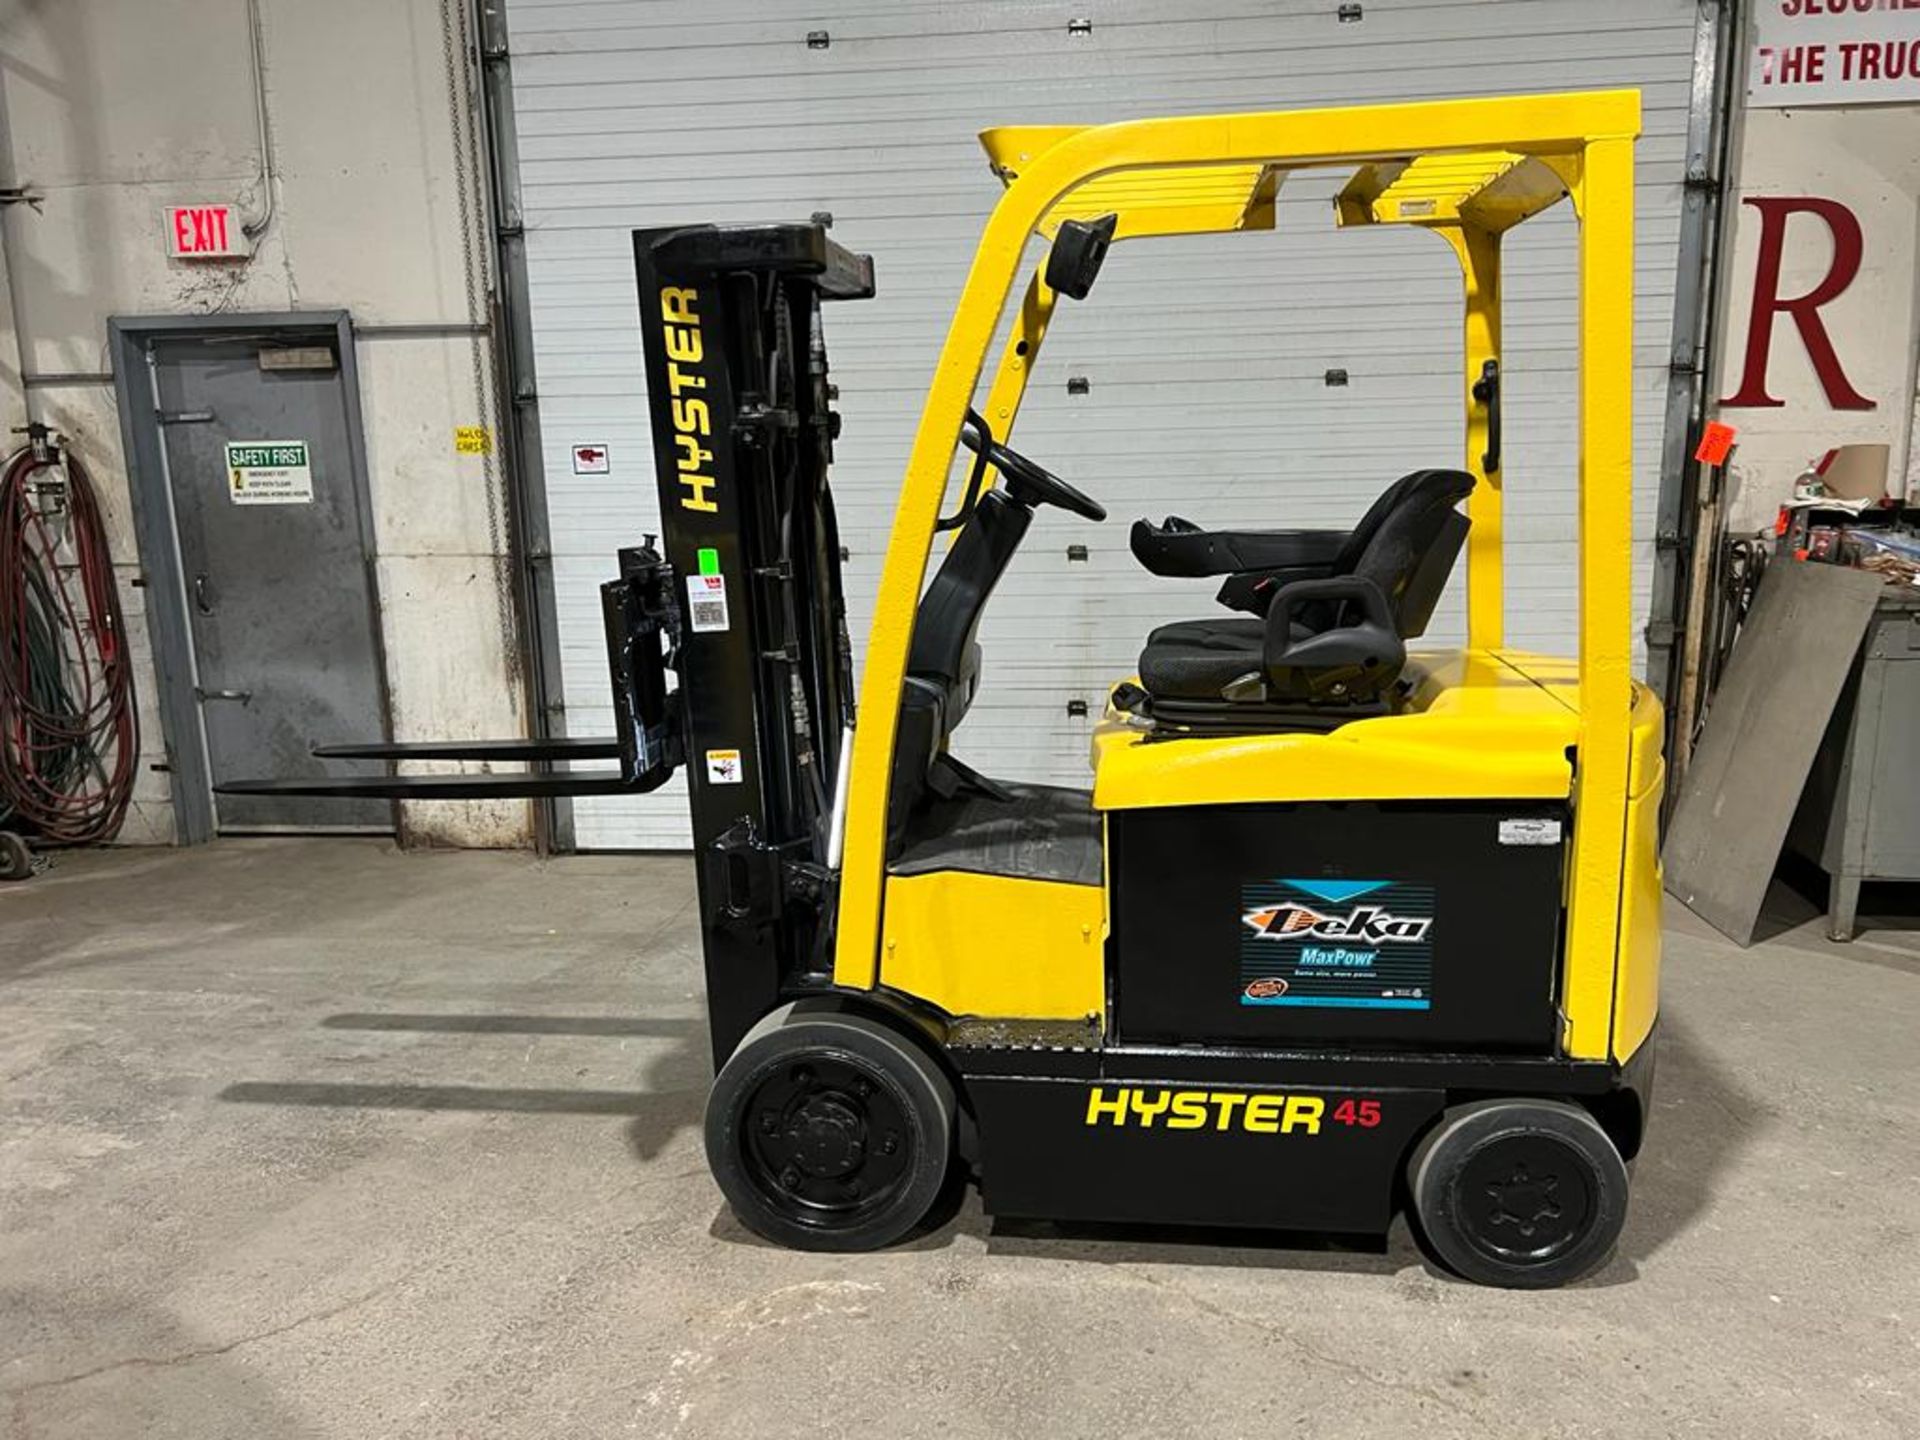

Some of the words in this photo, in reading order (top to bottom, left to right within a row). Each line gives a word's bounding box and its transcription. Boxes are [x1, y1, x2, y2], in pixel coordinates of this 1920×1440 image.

[1759, 45, 1826, 85] THE
[174, 208, 228, 253] EXIT
[1717, 196, 1877, 411] R
[660, 286, 718, 514] HYSTER
[230, 449, 271, 466] SAFETY
[272, 448, 302, 464] FIRST
[1242, 902, 1433, 944] Deka
[1300, 948, 1376, 967] MaxPowr
[1086, 1088, 1325, 1135] HYSTER
[1333, 1100, 1381, 1127] 45
